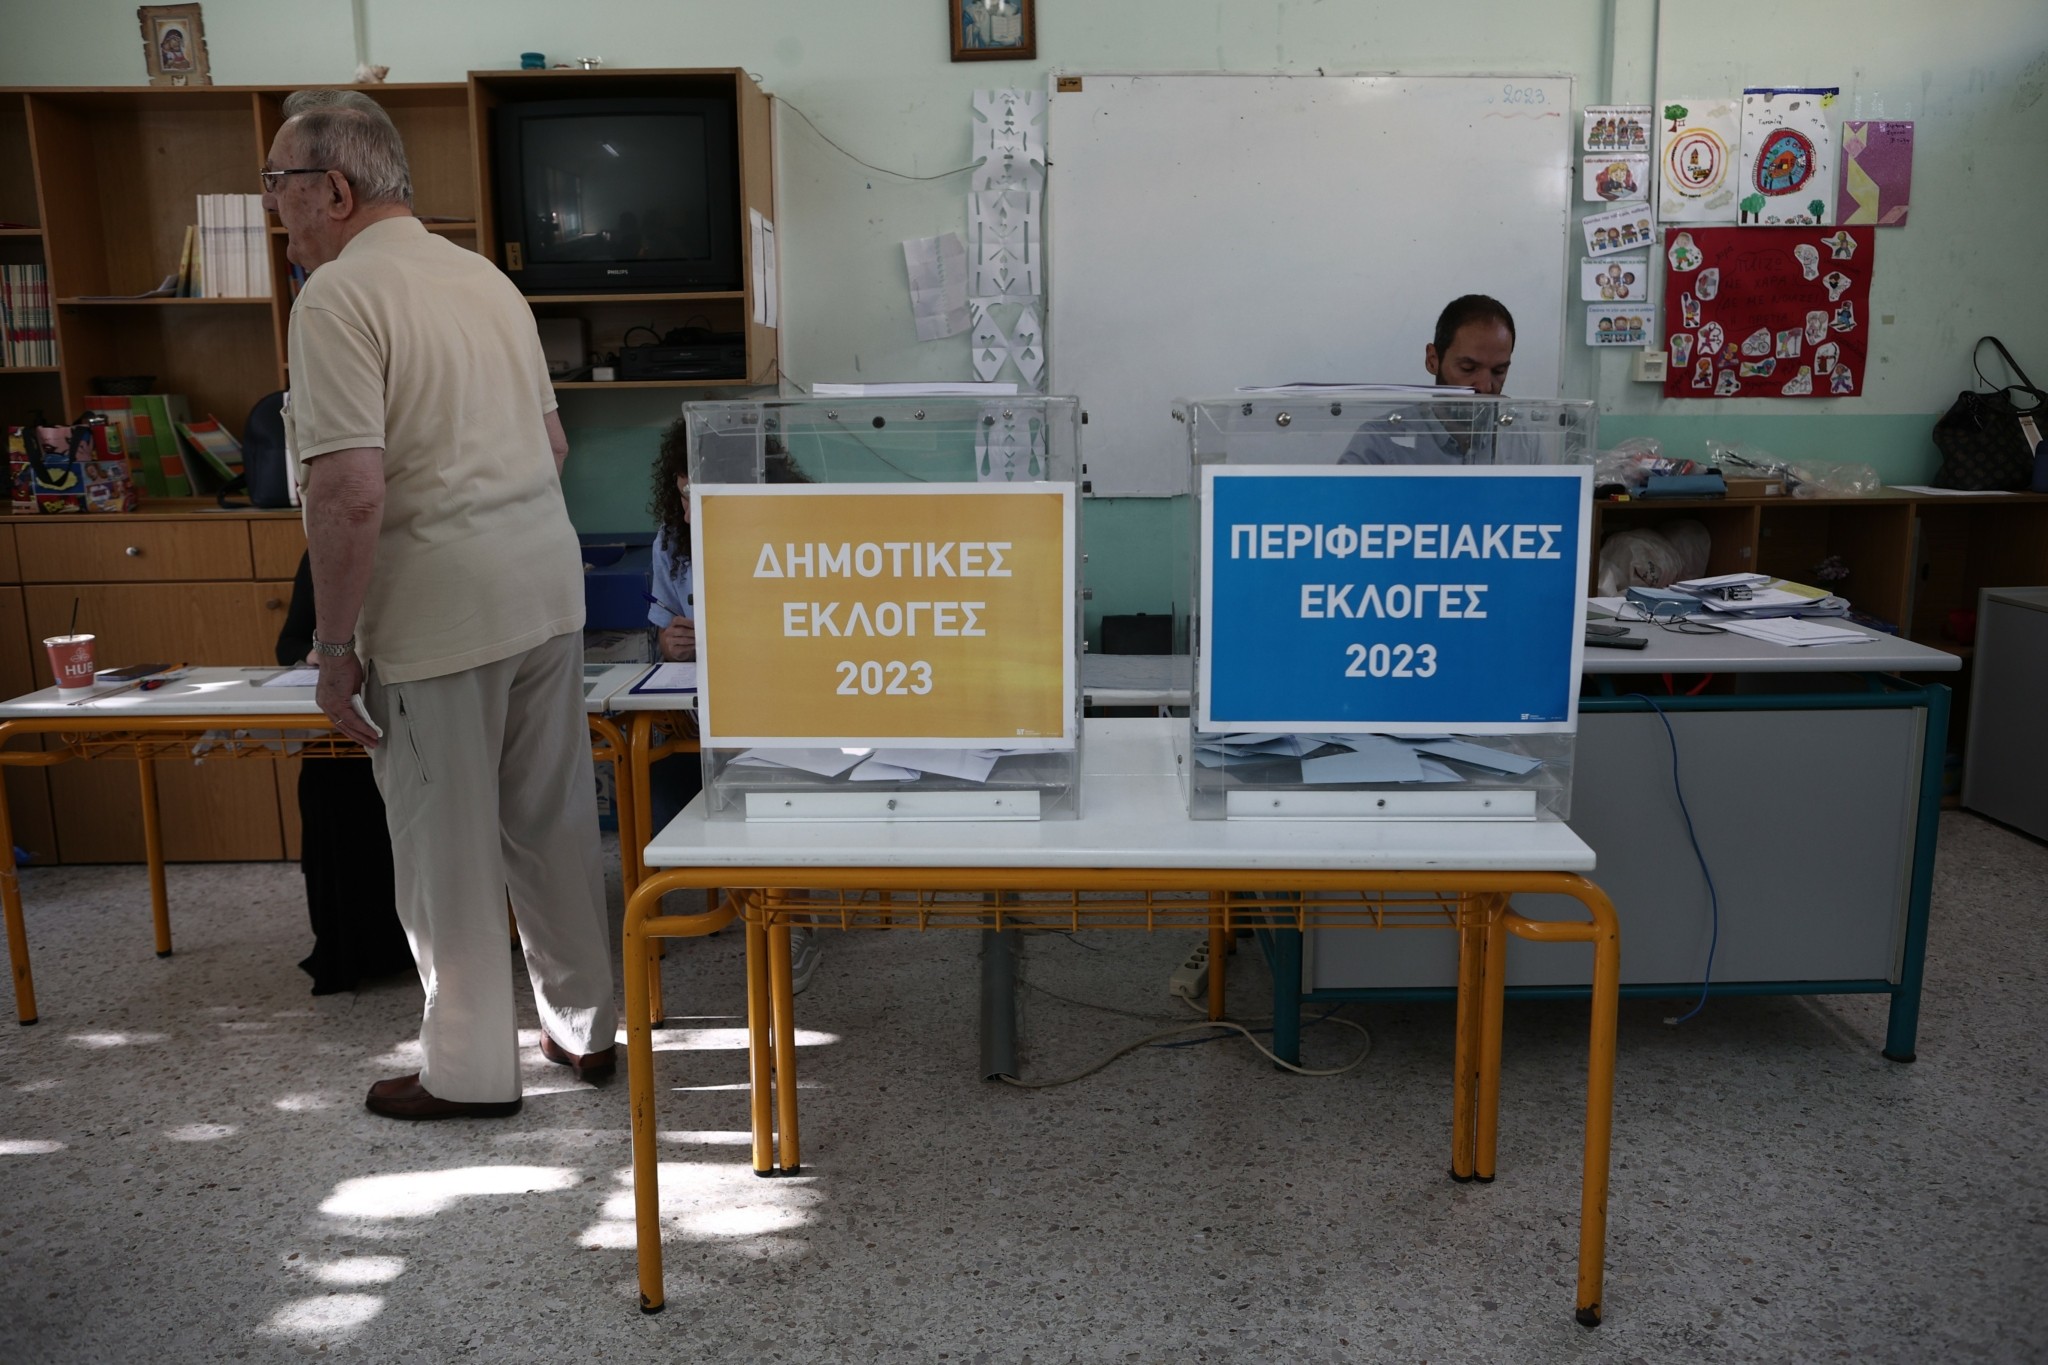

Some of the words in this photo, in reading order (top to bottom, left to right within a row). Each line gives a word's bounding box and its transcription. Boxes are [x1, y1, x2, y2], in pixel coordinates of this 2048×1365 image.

[753, 541, 1013, 578] ΔΗΜΟΤΙΚΕΣ
[1231, 524, 1562, 560] ΠΕΡΙΦΕΡΕΙΑΚΕΣ
[783, 601, 986, 637] ΕΚΛΟΓΕΣ
[1301, 584, 1488, 619] ΕΚΛΟΓΕΣ
[64, 661, 94, 676] HUB
[836, 660, 933, 696] 2023
[1345, 643, 1437, 678] 2023
